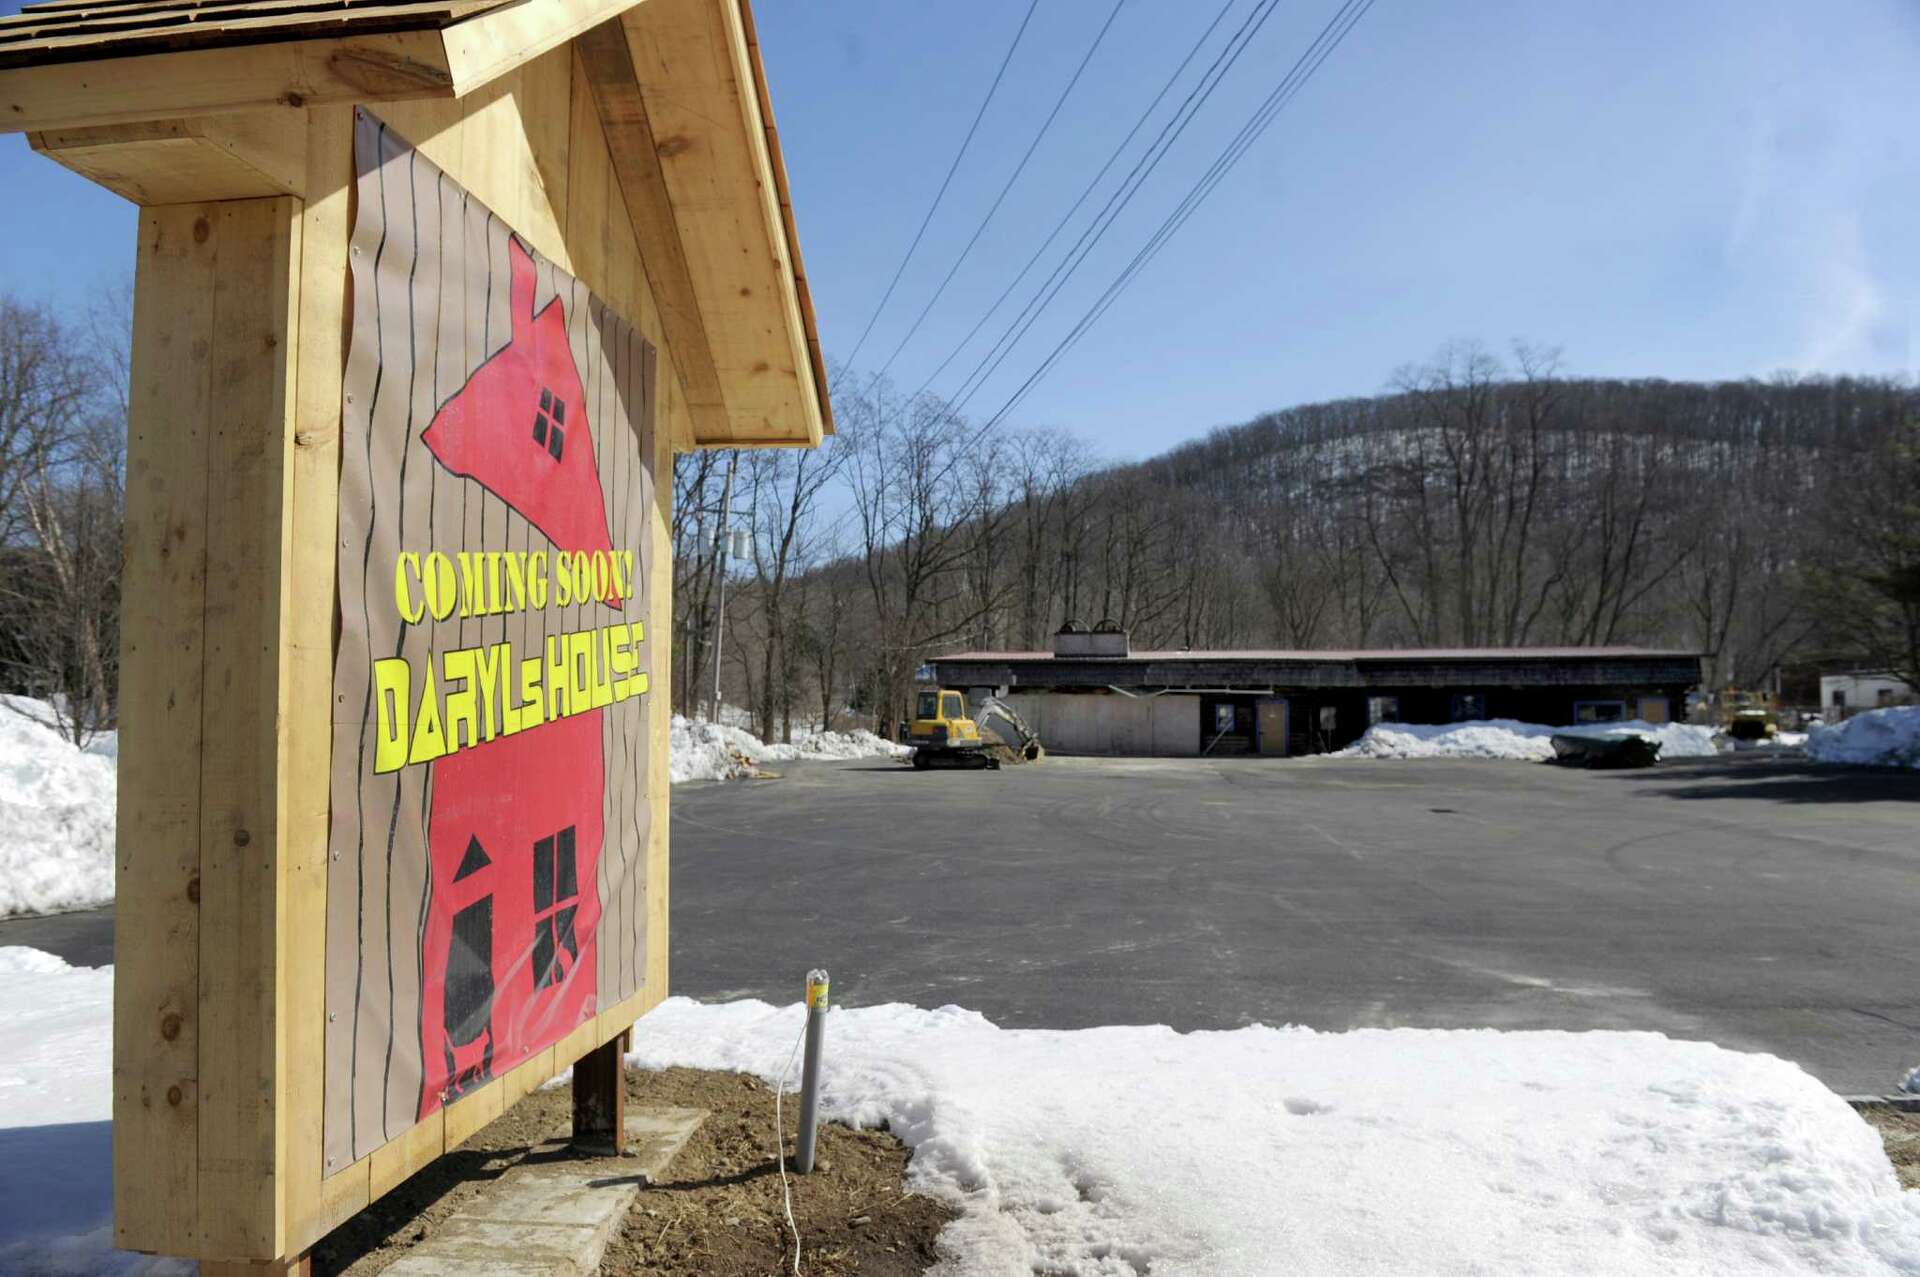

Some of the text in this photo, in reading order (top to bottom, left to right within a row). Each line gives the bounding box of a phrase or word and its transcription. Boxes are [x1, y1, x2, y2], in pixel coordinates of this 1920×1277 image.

[394, 549, 634, 625] COMING SOON!
[547, 621, 649, 723] HOUSE
